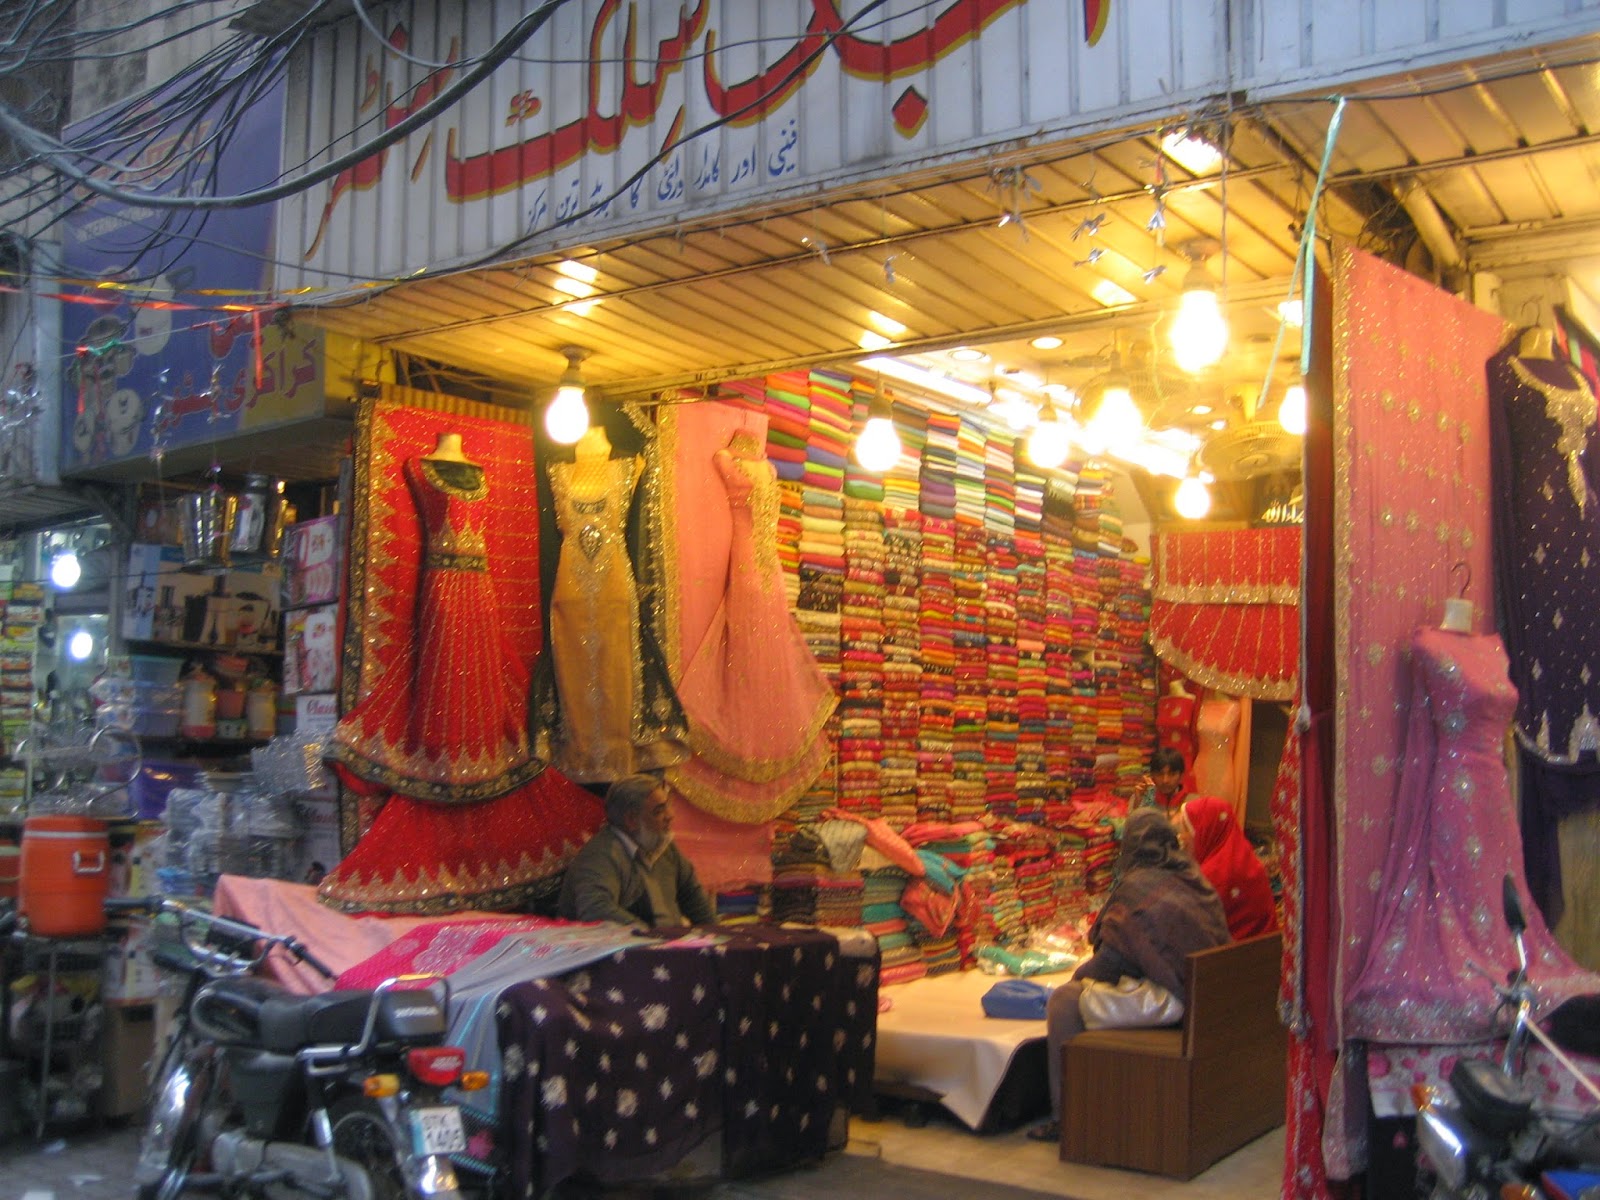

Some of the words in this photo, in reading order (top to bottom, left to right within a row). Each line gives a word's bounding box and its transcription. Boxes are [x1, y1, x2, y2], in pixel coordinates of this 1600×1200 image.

[730, 144, 756, 183] اور
[525, 187, 547, 236] مرکز
[556, 179, 580, 229] ترین
[630, 174, 644, 209] کا
